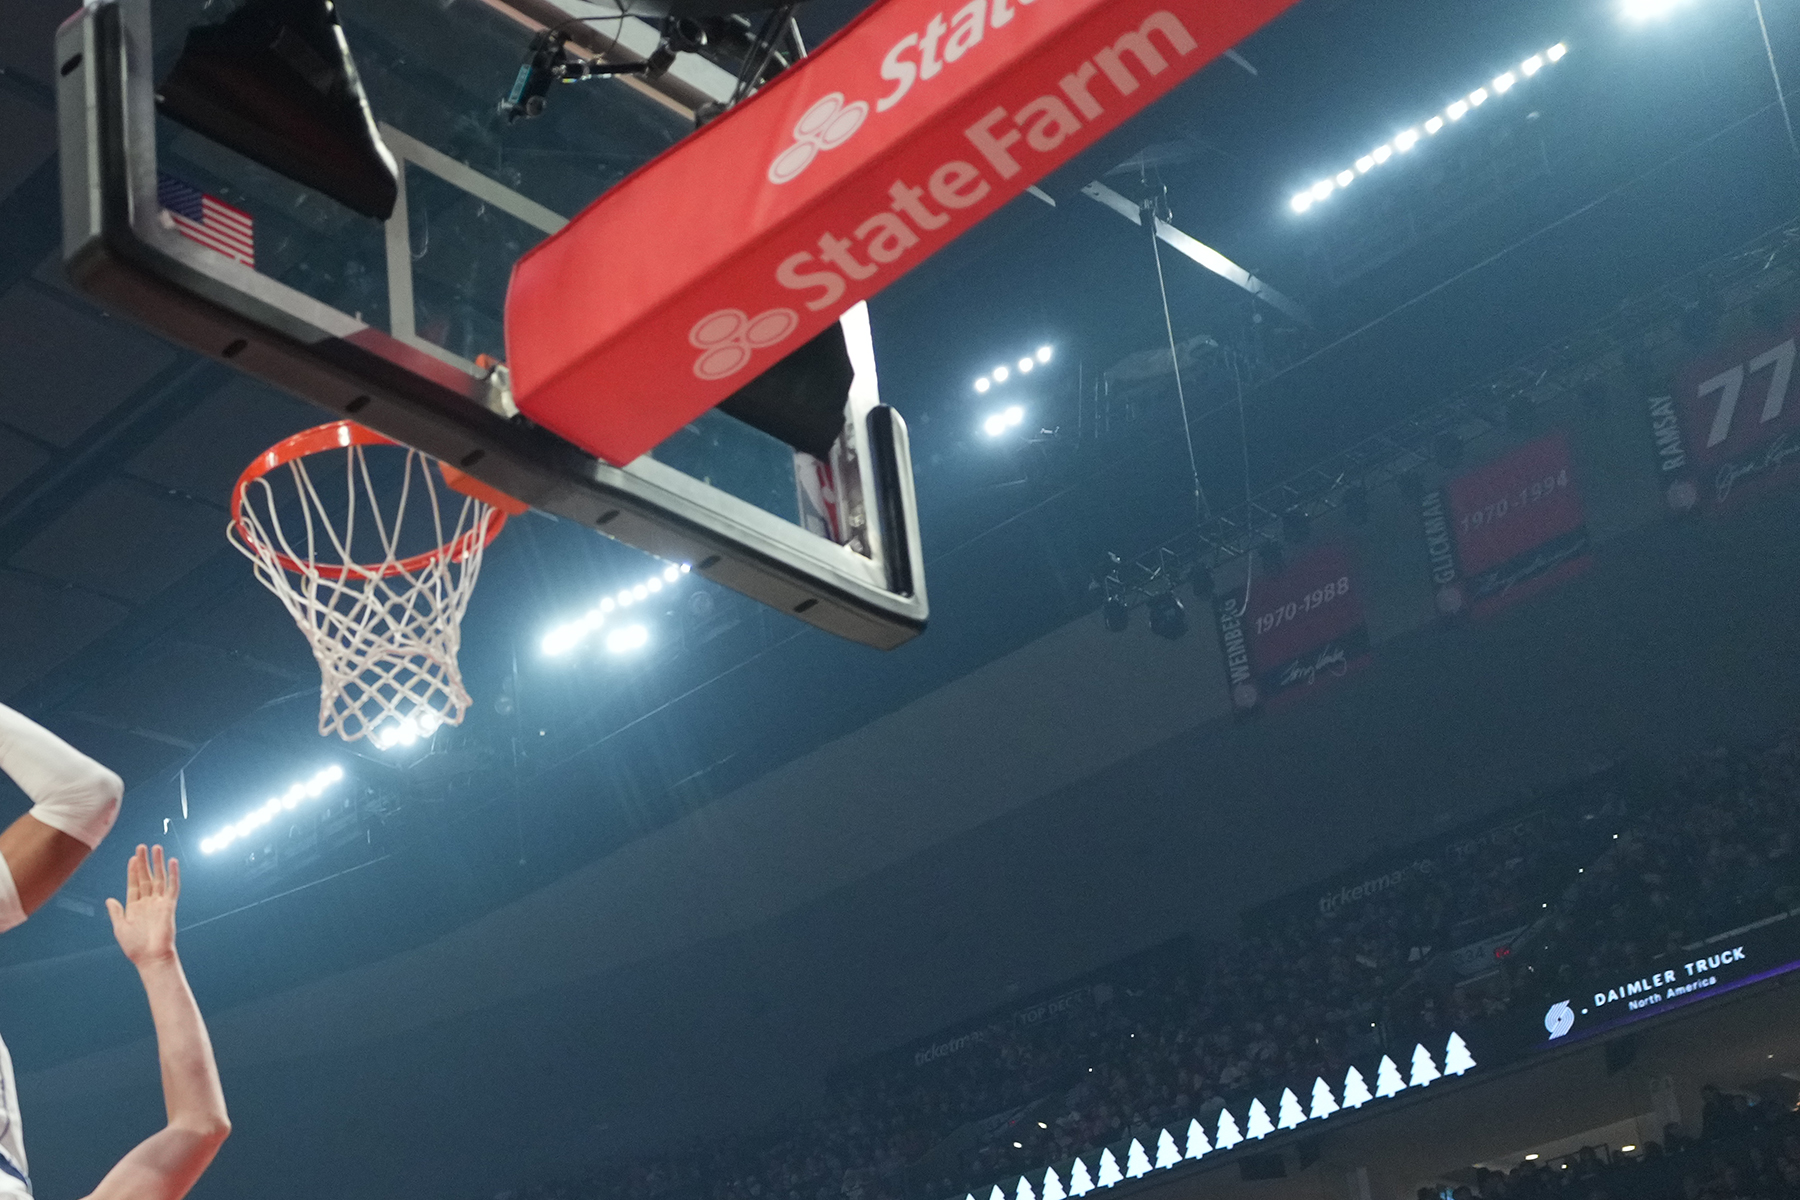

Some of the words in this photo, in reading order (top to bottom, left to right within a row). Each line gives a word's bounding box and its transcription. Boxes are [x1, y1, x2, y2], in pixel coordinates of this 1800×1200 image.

[1697, 337, 1798, 449] 77
[1648, 394, 1686, 472] RAMSAY
[1461, 468, 1569, 532] 1970-1994
[1421, 491, 1455, 584] GLICKMAN
[1255, 576, 1350, 634] 1970-1988
[1221, 597, 1251, 686] WEINBERG
[1594, 970, 1676, 1007] DAIMLER
[1684, 946, 1746, 976] TRUCK
[1628, 992, 1662, 1011] North
[1666, 976, 1717, 999] America
